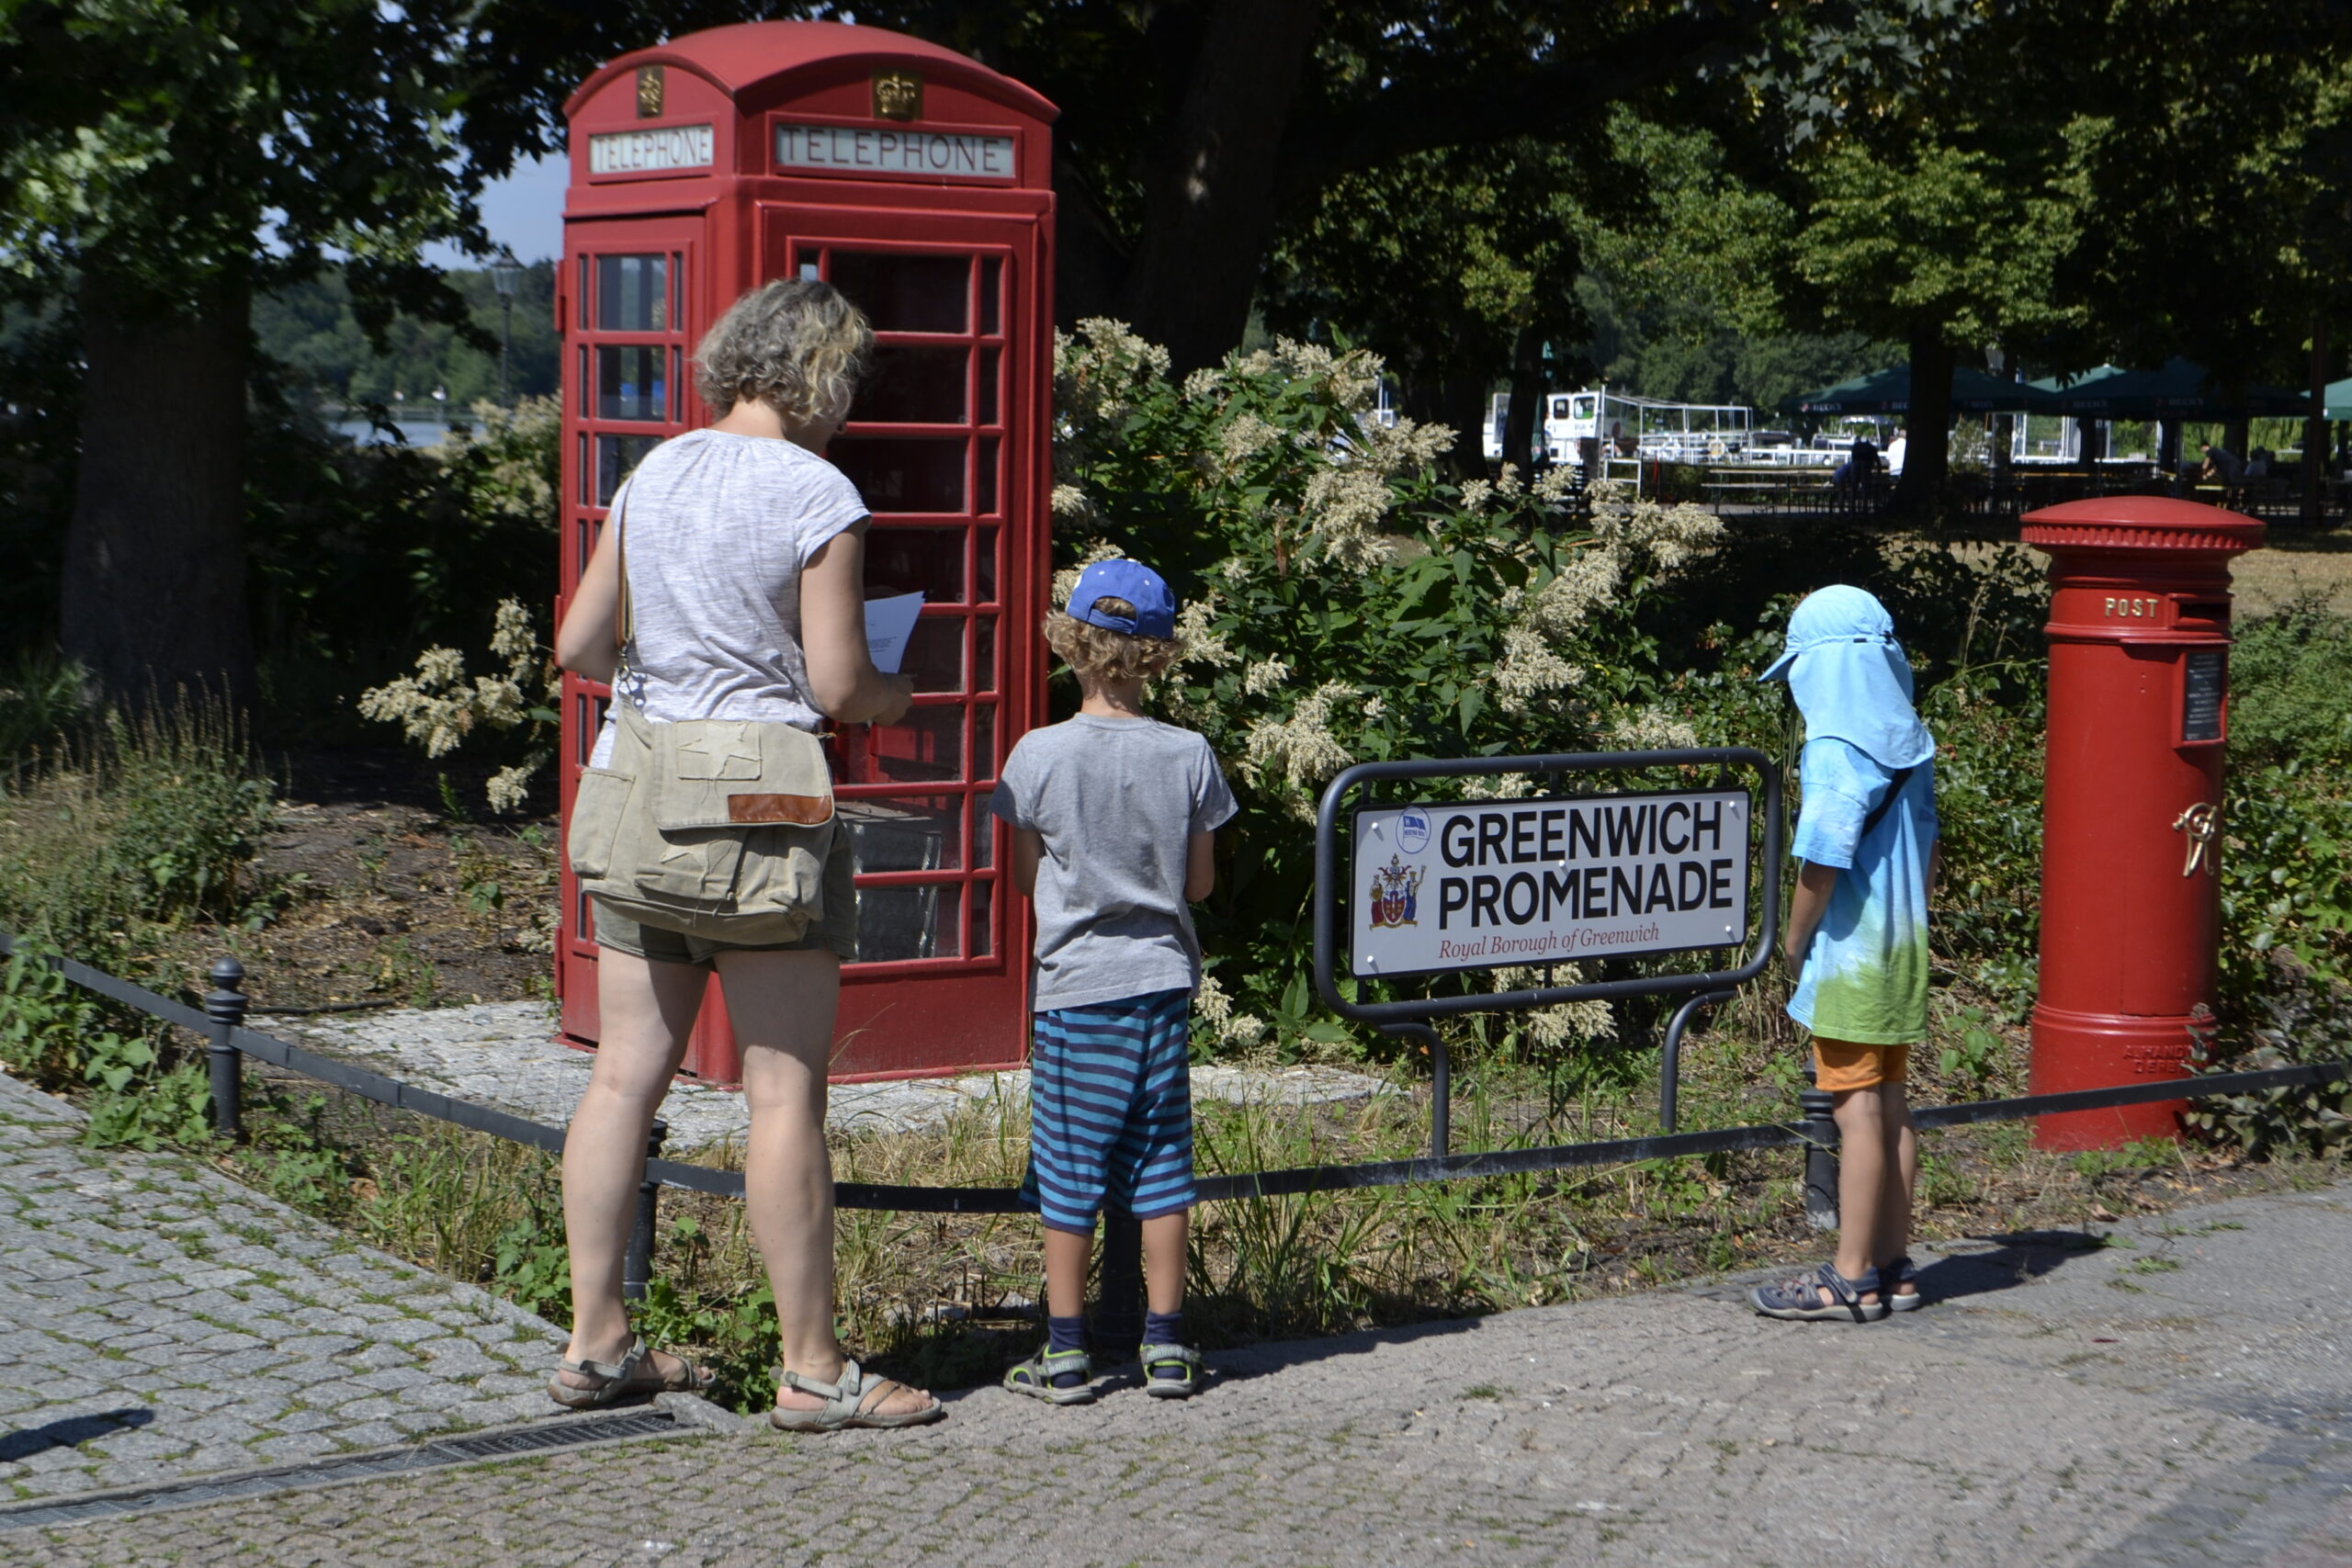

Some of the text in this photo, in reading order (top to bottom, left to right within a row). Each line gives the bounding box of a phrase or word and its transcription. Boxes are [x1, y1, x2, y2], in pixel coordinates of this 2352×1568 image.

[595, 127, 710, 171] TELEPHONE
[781, 127, 1001, 173] TELEPHONE
[2104, 597, 2159, 617] POST
[1440, 800, 1723, 868] GREENWICH
[1439, 858, 1733, 931] PROMENADE
[1438, 922, 1660, 962] Royal Borough of Greenwich
